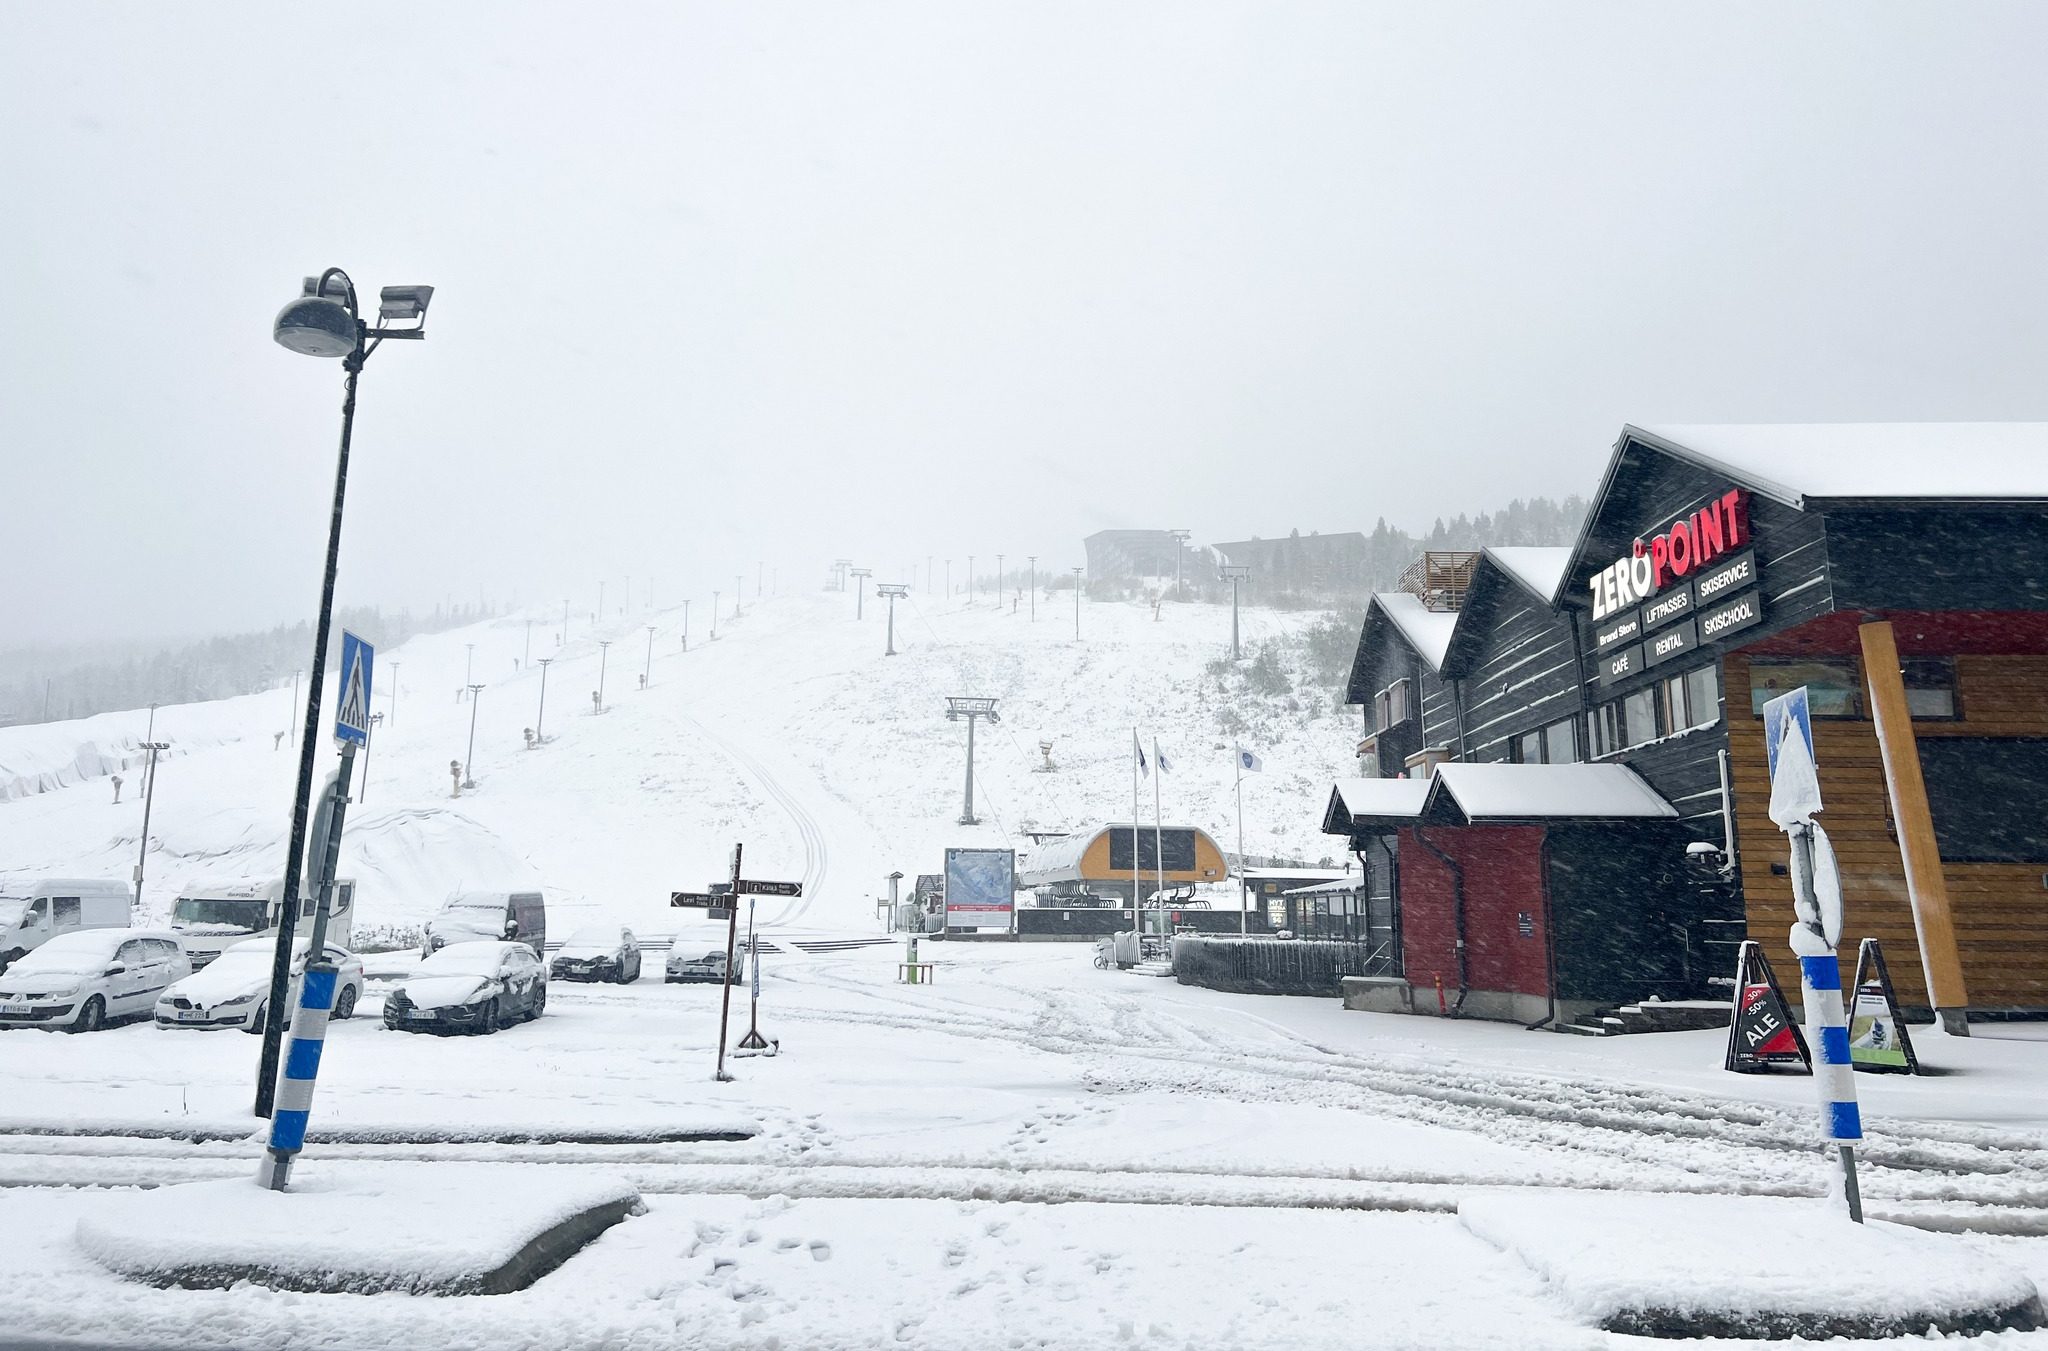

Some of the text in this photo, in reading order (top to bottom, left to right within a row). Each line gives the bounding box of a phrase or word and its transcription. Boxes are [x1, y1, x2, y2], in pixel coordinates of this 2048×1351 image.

[1652, 488, 1741, 587] POINT
[1701, 561, 1749, 597] SKISERVICE
[1646, 592, 1688, 624] LIFTPASSES
[1704, 602, 1753, 635] SKISCHOOL
[1600, 621, 1637, 646] Brand Store
[1656, 633, 1683, 656] RENTAL
[1612, 654, 1629, 675] CAFÉ
[1748, 999, 1767, 1016] -50%
[1746, 1013, 1780, 1047] ALE
